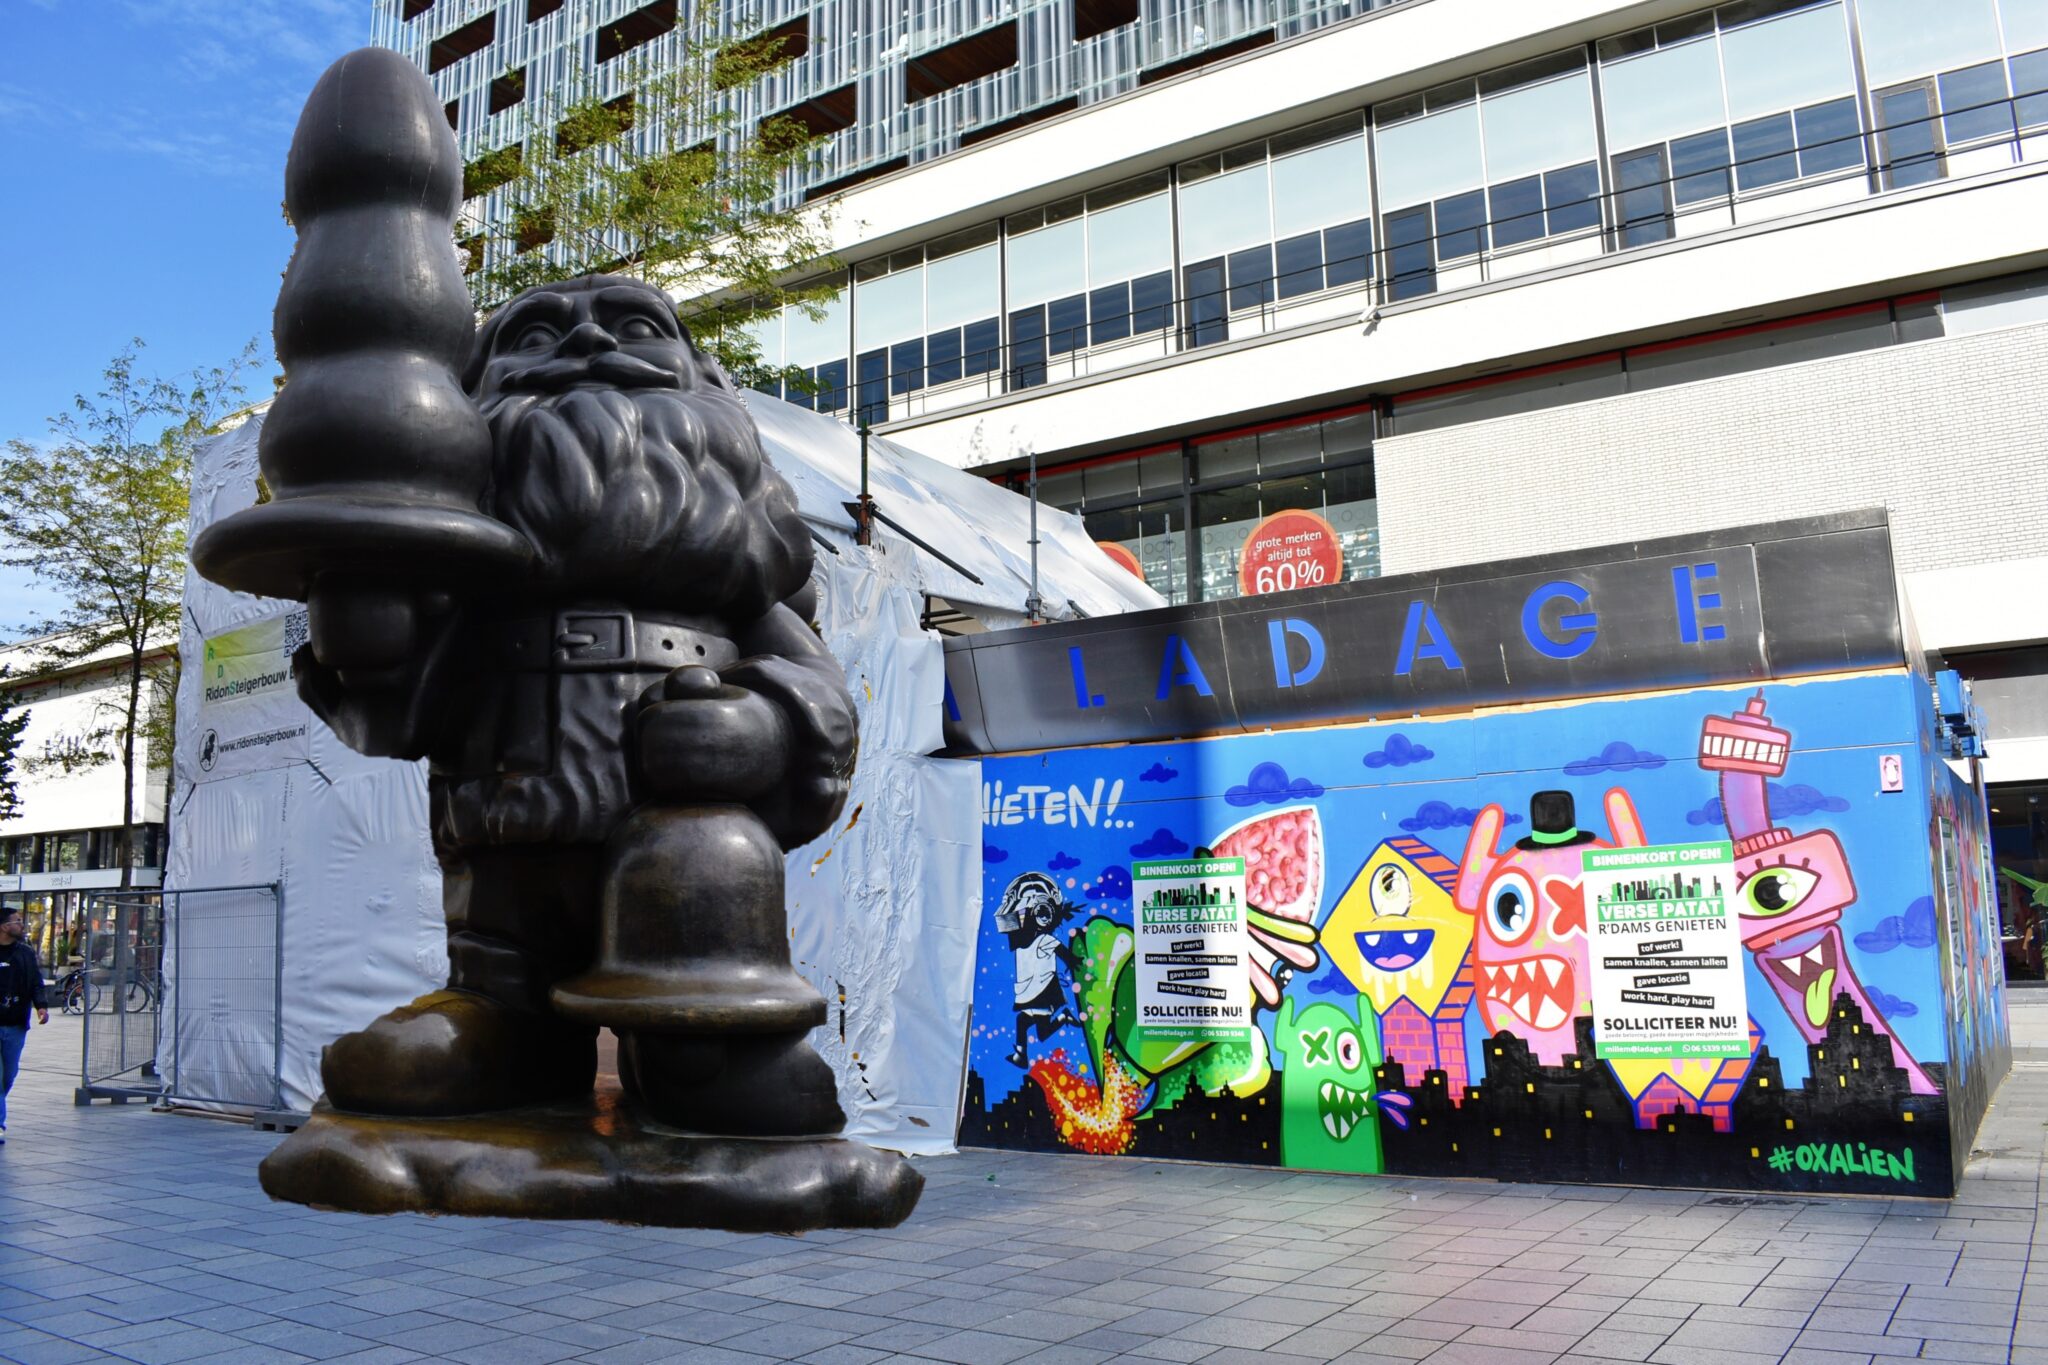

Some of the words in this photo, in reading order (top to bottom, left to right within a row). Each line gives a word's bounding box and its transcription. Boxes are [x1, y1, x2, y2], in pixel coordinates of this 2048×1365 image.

[1256, 537, 1281, 552] grote
[1285, 531, 1322, 544] merken
[1267, 548, 1293, 562] altijd
[1296, 546, 1312, 557] tot
[1256, 559, 1325, 594] 60%
[206, 669, 287, 702] RidonSteigerbouw
[219, 724, 306, 754] www.ridonsteigerbouw.nl
[1592, 850, 1677, 867] BINNENKORT
[1679, 848, 1722, 861] OPEN!
[1140, 864, 1202, 876] BINNENKORT
[1204, 862, 1237, 873] OPEN!
[1144, 908, 1188, 922] VERSE
[1191, 906, 1235, 920] PATAT
[1600, 903, 1658, 920] VERSE
[1662, 900, 1721, 917] PATAT
[1142, 923, 1182, 935] R'DAMS
[1184, 922, 1238, 934] GENIETEN
[1599, 922, 1651, 935] R'DAMS
[1655, 918, 1727, 932] GENIETEN
[1173, 942, 1183, 951] tof
[1184, 941, 1203, 950] werk!
[1640, 943, 1653, 953] tof
[1655, 941, 1679, 951] werk!
[1168, 955, 1194, 964] knallen,
[1217, 955, 1237, 965] lallen
[1605, 959, 1633, 967] samen
[1634, 958, 1668, 968] knallen,
[1701, 958, 1726, 967] lallen
[1169, 971, 1185, 981] gave
[1185, 969, 1208, 979] locatie
[1636, 978, 1657, 988] gave
[1658, 974, 1688, 984] locatie
[1159, 984, 1176, 993] work
[1176, 985, 1194, 995] hard,
[1194, 987, 1210, 998] play
[1210, 989, 1226, 999] hard
[1624, 992, 1646, 1001] work
[1647, 994, 1670, 1004] hard,
[1671, 996, 1691, 1007] play
[1692, 997, 1713, 1007] hard
[1143, 1006, 1219, 1018] SOLLICITEER
[1221, 1006, 1243, 1017] NU!
[1603, 1018, 1705, 1031] SOLLICITEER
[1709, 1016, 1738, 1029] NU!
